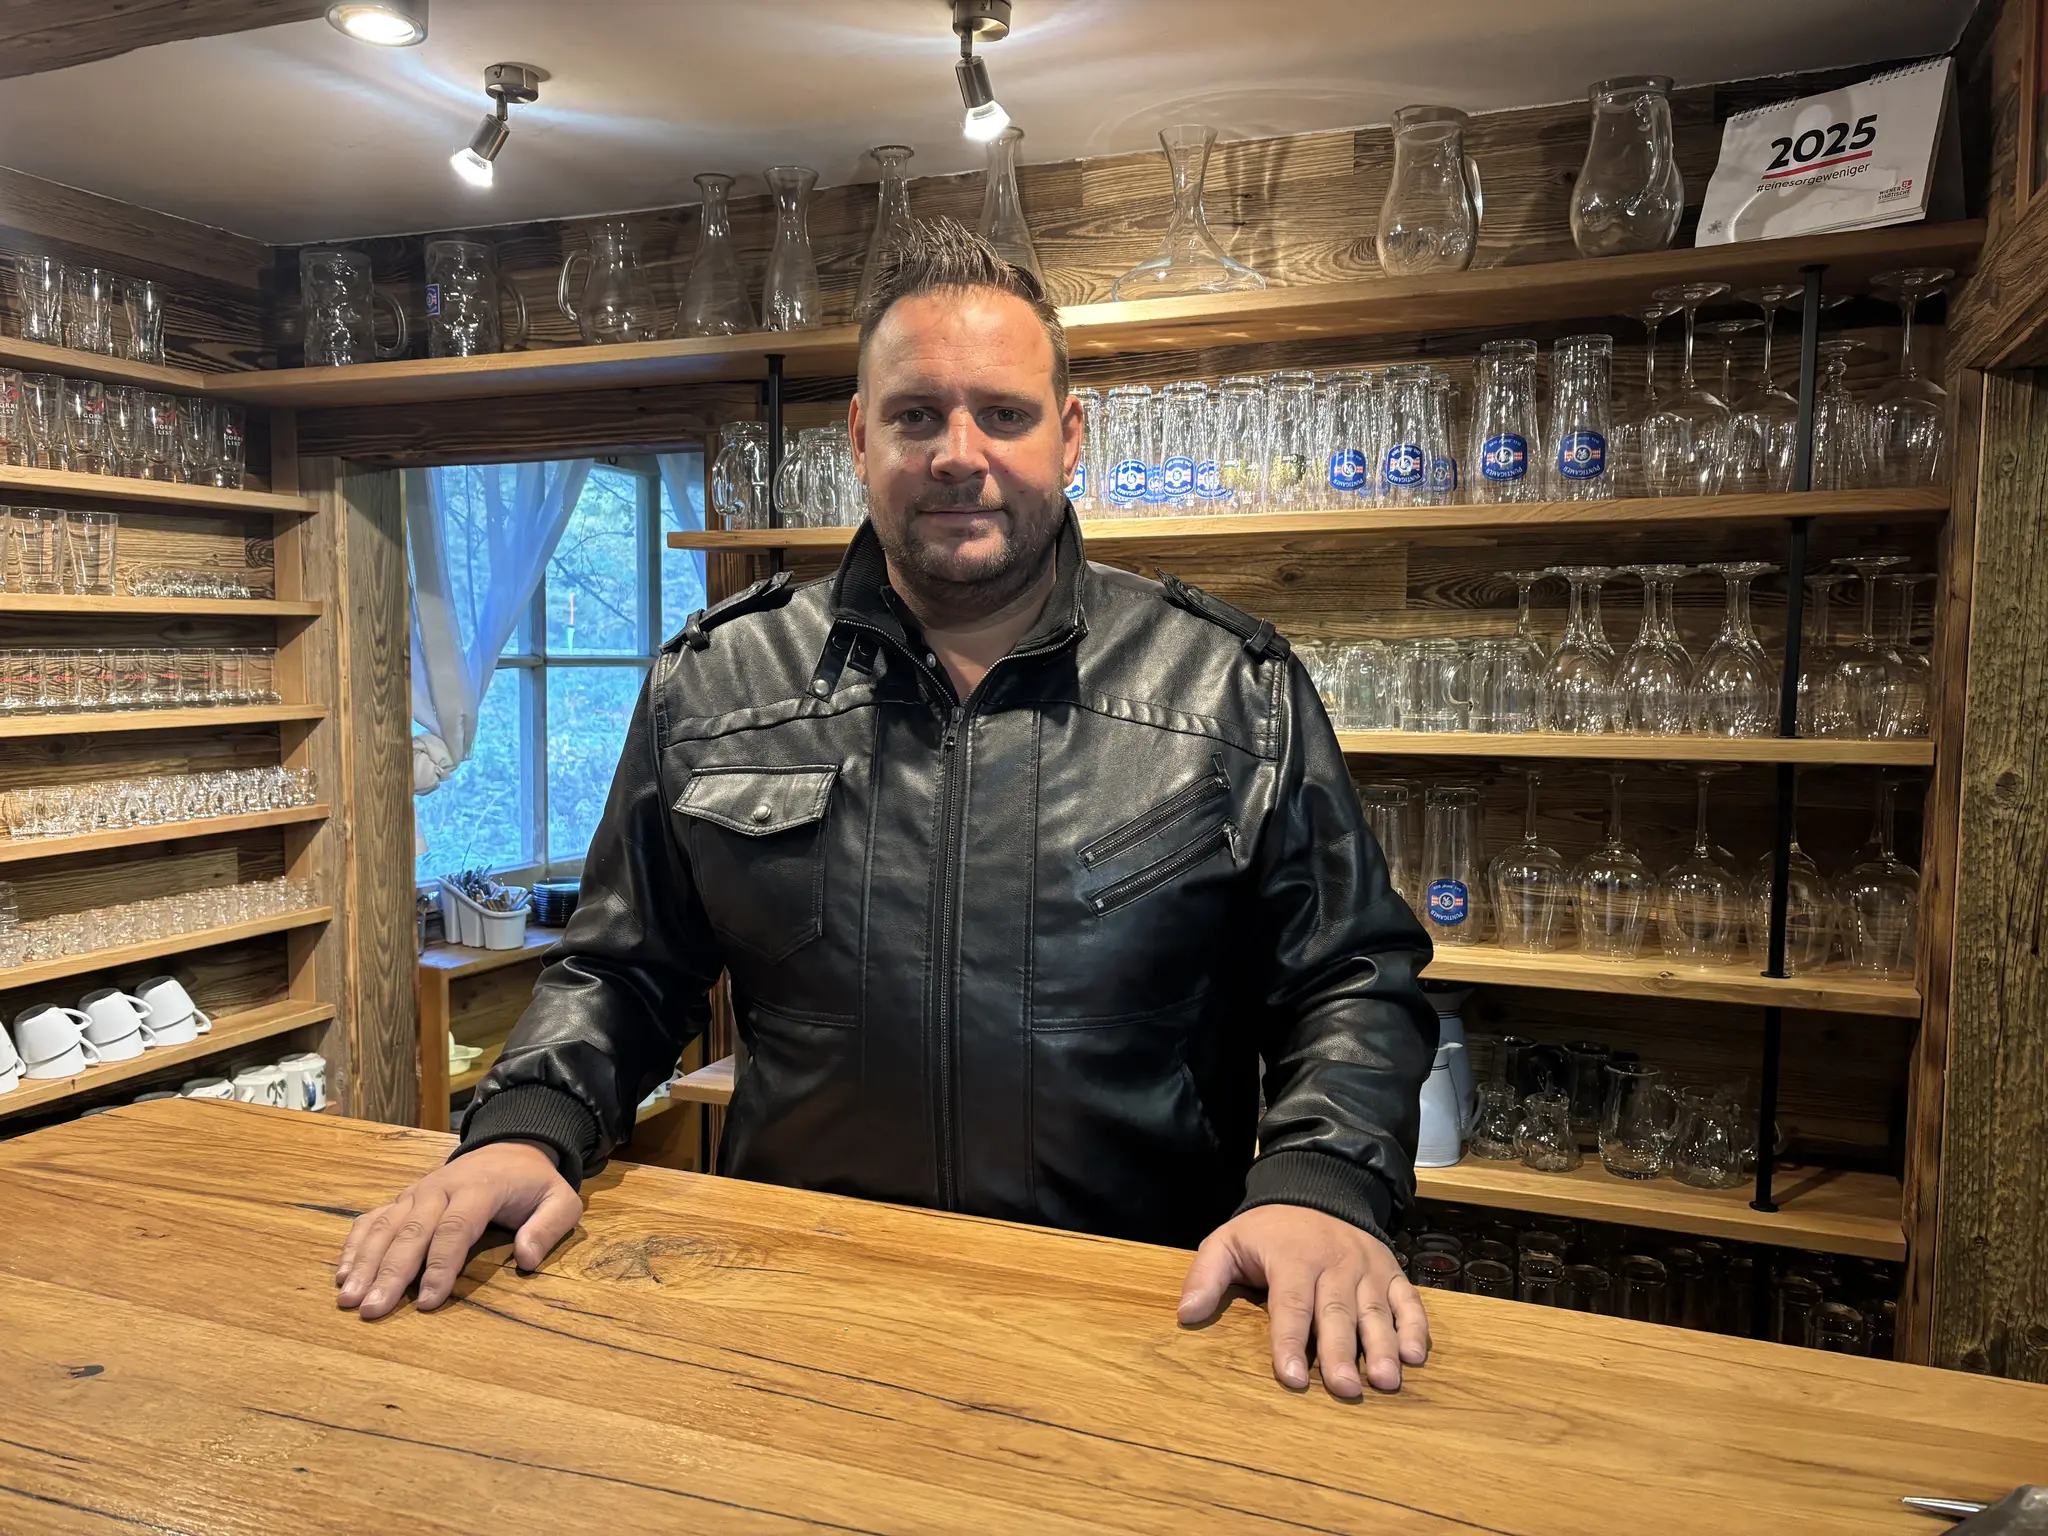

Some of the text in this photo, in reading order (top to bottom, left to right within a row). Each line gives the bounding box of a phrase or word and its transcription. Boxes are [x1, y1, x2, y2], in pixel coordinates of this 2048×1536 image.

[1765, 114, 1878, 172] 2025
[1756, 163, 1870, 193] #einesorgeweniger
[1485, 466, 1523, 477] PUNTIGAMER
[1563, 464, 1601, 476] PUNTIGAMER
[1332, 478, 1364, 487] PUNTIGAMER
[1388, 473, 1421, 484] PUNTIGAMER
[1430, 909, 1464, 921] PUNTIGAMER
